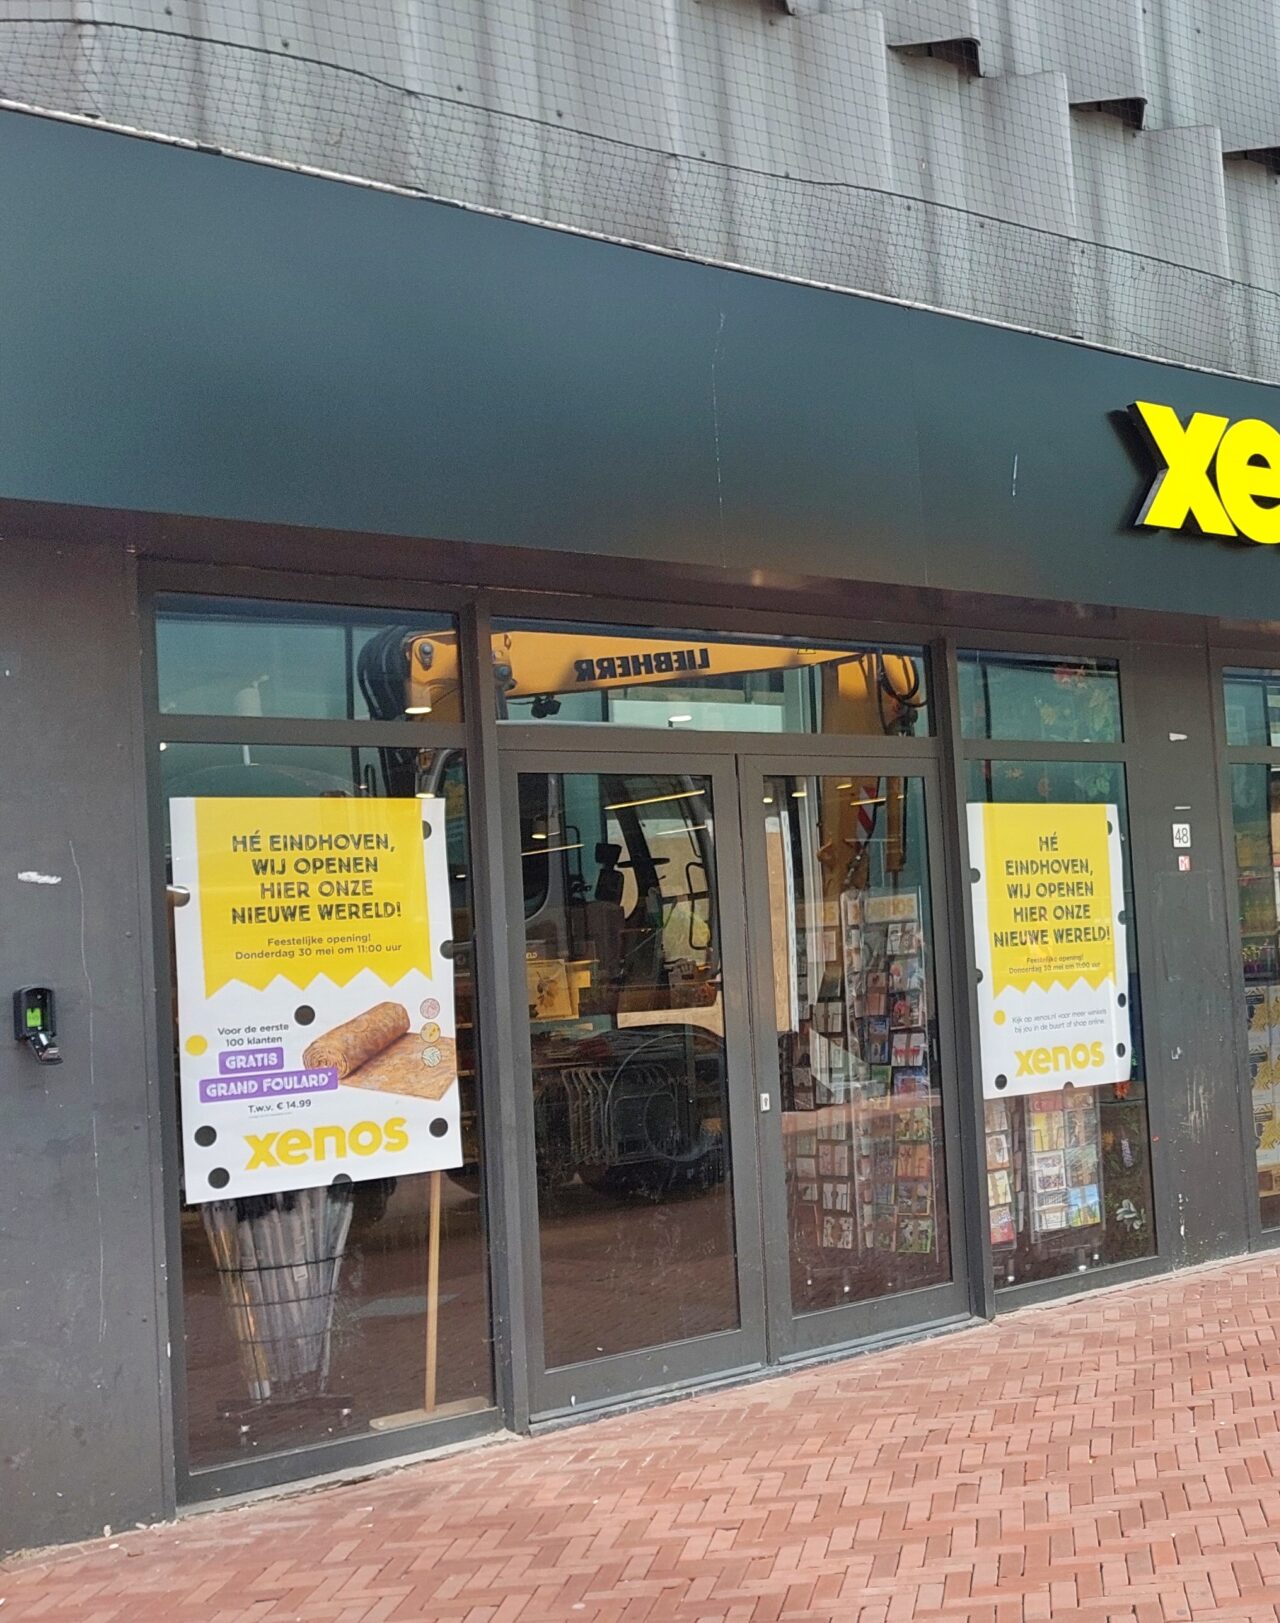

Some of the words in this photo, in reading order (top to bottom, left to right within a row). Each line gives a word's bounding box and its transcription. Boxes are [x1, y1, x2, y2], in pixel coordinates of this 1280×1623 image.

[232, 830, 262, 852] HÉ
[269, 833, 395, 852] EINDHOVEN,
[1038, 832, 1058, 852] HÉ
[1174, 827, 1189, 844] 48
[252, 858, 286, 875] WIJ
[293, 856, 378, 874] OPENEN
[1005, 858, 1094, 876] EINDHOVEN,
[260, 881, 311, 899] HIER
[318, 879, 373, 897] ONZE
[1006, 883, 1031, 899] WIJ
[1035, 881, 1094, 898] OPENEN
[231, 904, 311, 924] NIEUWE
[317, 901, 402, 920] WERELD!
[1013, 906, 1048, 922] HIER
[1053, 904, 1091, 920] ONZE
[267, 936, 323, 946] Feestelijke
[326, 933, 371, 944] opening!
[993, 929, 1049, 947] NIEUWE
[1053, 926, 1111, 944] WERELD!
[235, 949, 295, 960] Donderdag
[298, 947, 312, 957] 30
[315, 946, 334, 956] mei
[338, 946, 354, 955] om
[358, 943, 382, 953] 11:00
[385, 943, 402, 952] uur
[217, 1026, 243, 1036] Voor
[244, 1025, 257, 1034] de
[259, 1023, 289, 1032] eerste
[226, 1037, 245, 1047] 100
[247, 1035, 283, 1046] klanten
[225, 1052, 278, 1070] GRATIS
[1014, 1041, 1105, 1077] xenos
[206, 1079, 258, 1098] GRAND
[286, 1099, 312, 1109] 14.99
[243, 1117, 409, 1170] xenos
